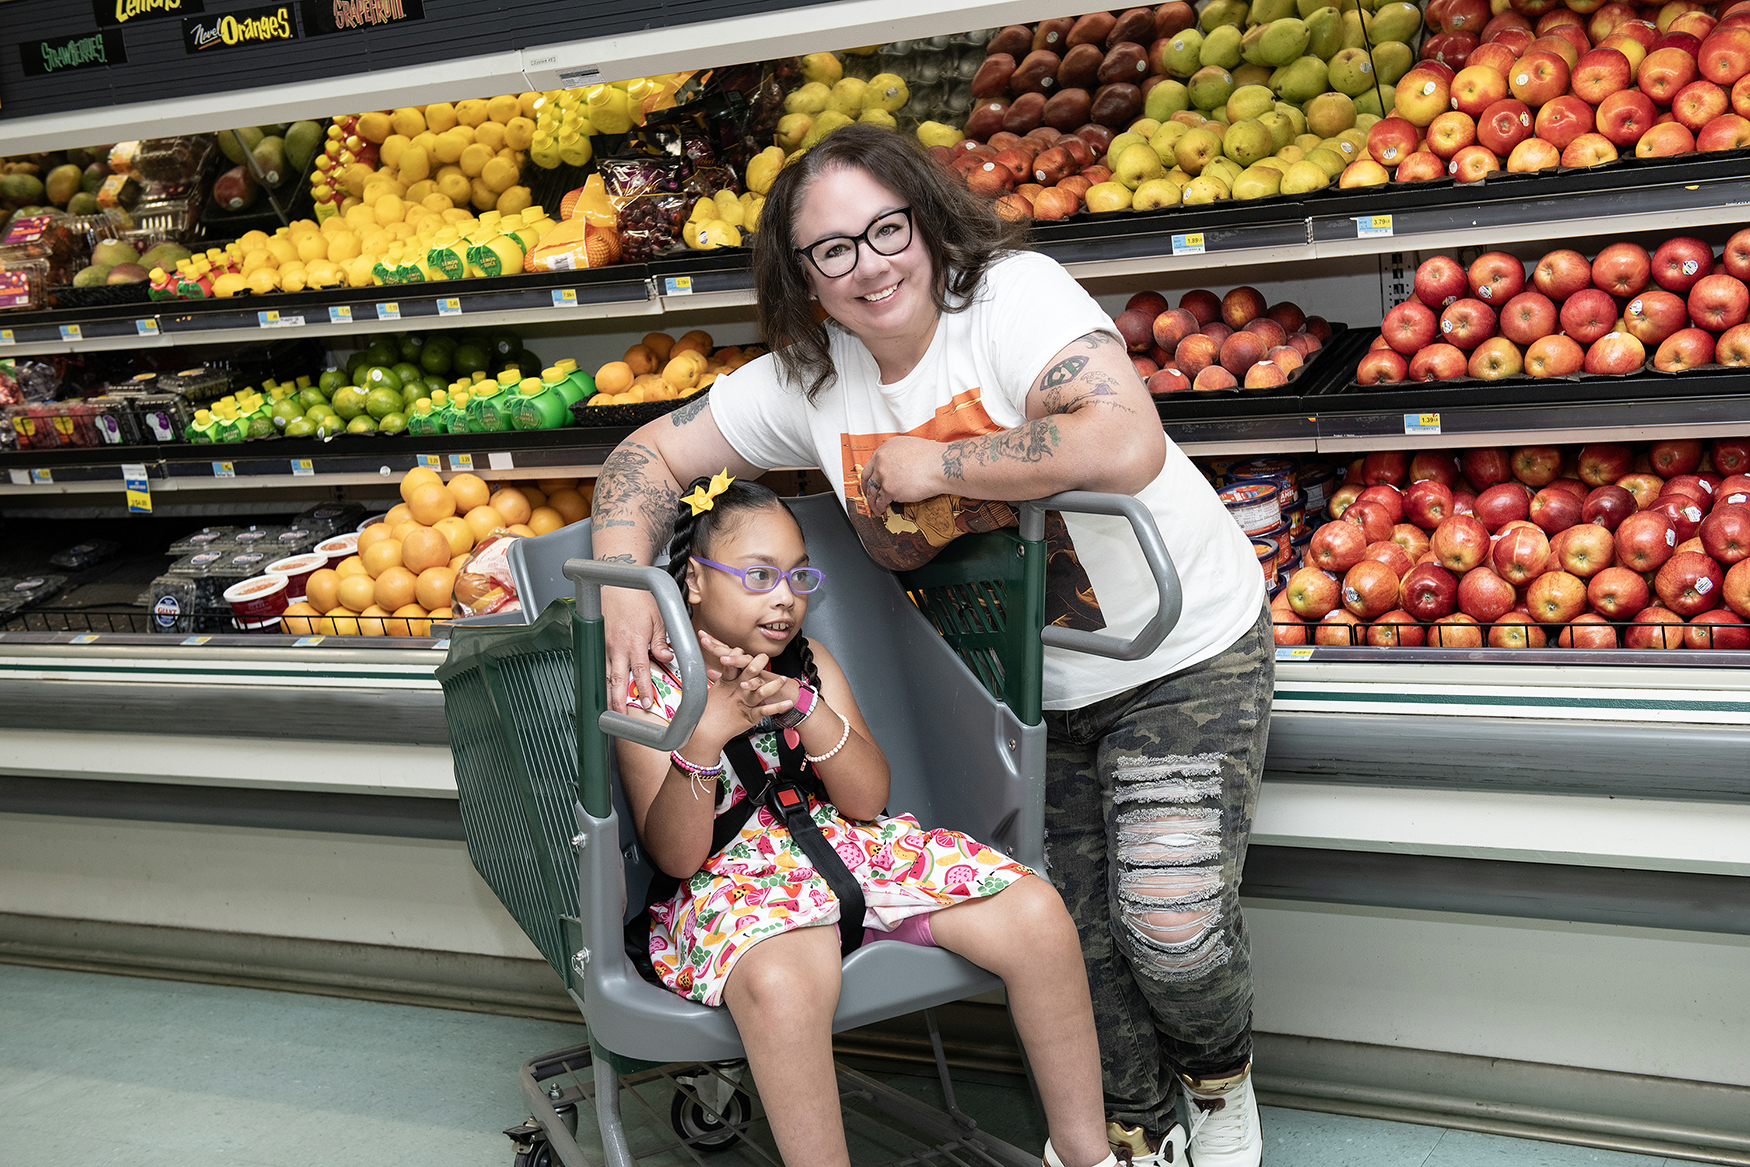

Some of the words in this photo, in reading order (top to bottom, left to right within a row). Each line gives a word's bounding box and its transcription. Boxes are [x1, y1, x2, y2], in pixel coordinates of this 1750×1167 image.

[115, 0, 182, 23] Lemons
[220, 7, 290, 45] Oranges
[41, 34, 105, 72] STRAWBERRIES
